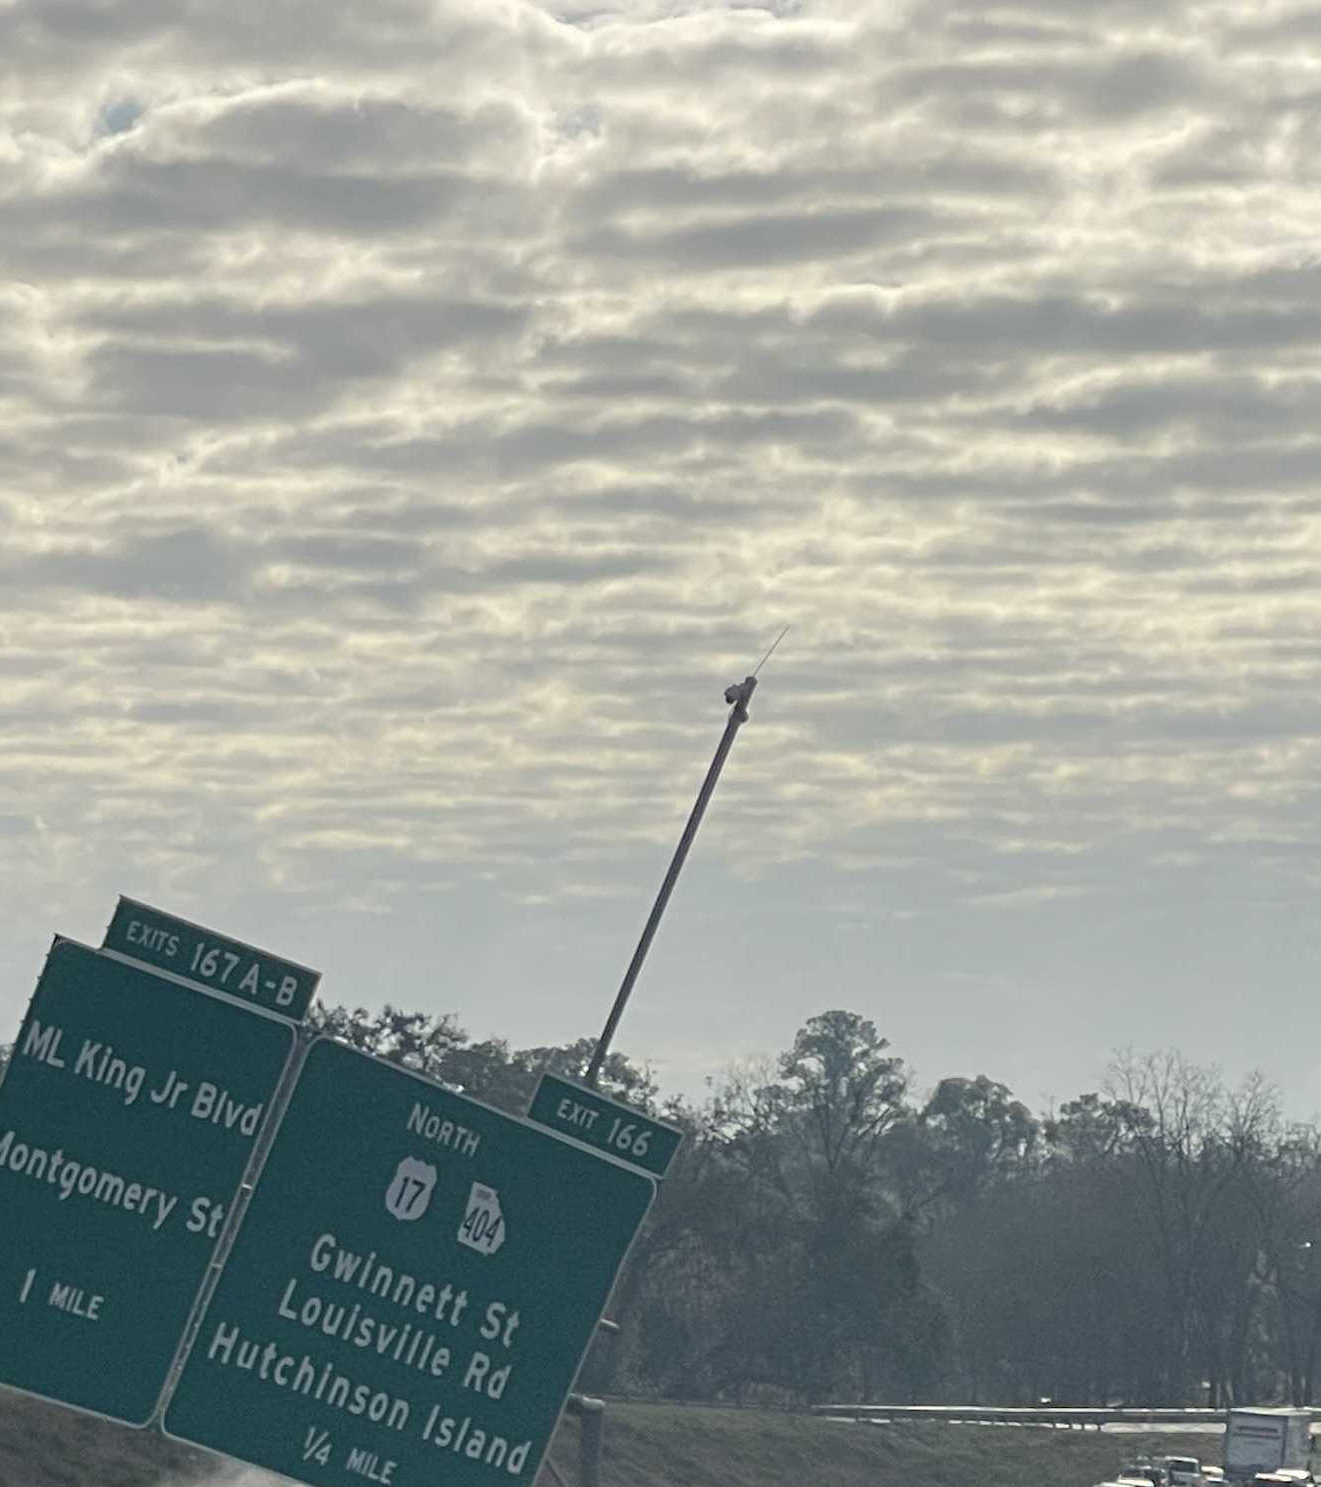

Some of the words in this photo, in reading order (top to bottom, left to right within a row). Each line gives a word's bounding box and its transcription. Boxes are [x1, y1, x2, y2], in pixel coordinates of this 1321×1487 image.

[126, 920, 180, 957] EXITS
[23, 1020, 66, 1069] ML
[74, 1040, 146, 1105] King
[150, 1071, 189, 1109] Jr
[191, 1082, 264, 1137] Blvd
[406, 1102, 482, 1158] NORTH
[556, 1099, 599, 1130] EXIT
[607, 1117, 653, 1157] 166
[186, 1197, 224, 1238] St
[393, 1175, 427, 1214] 17
[463, 1207, 503, 1247] 404
[19, 1268, 37, 1303] 1
[48, 1282, 105, 1321] MILE
[309, 1233, 469, 1328] Gwinnett
[479, 1301, 521, 1348] St
[278, 1278, 451, 1377] Louisville
[463, 1351, 512, 1400] Rd
[206, 1321, 411, 1431] Hutchinson
[421, 1404, 533, 1476] Island
[345, 1447, 399, 1487] MILE
